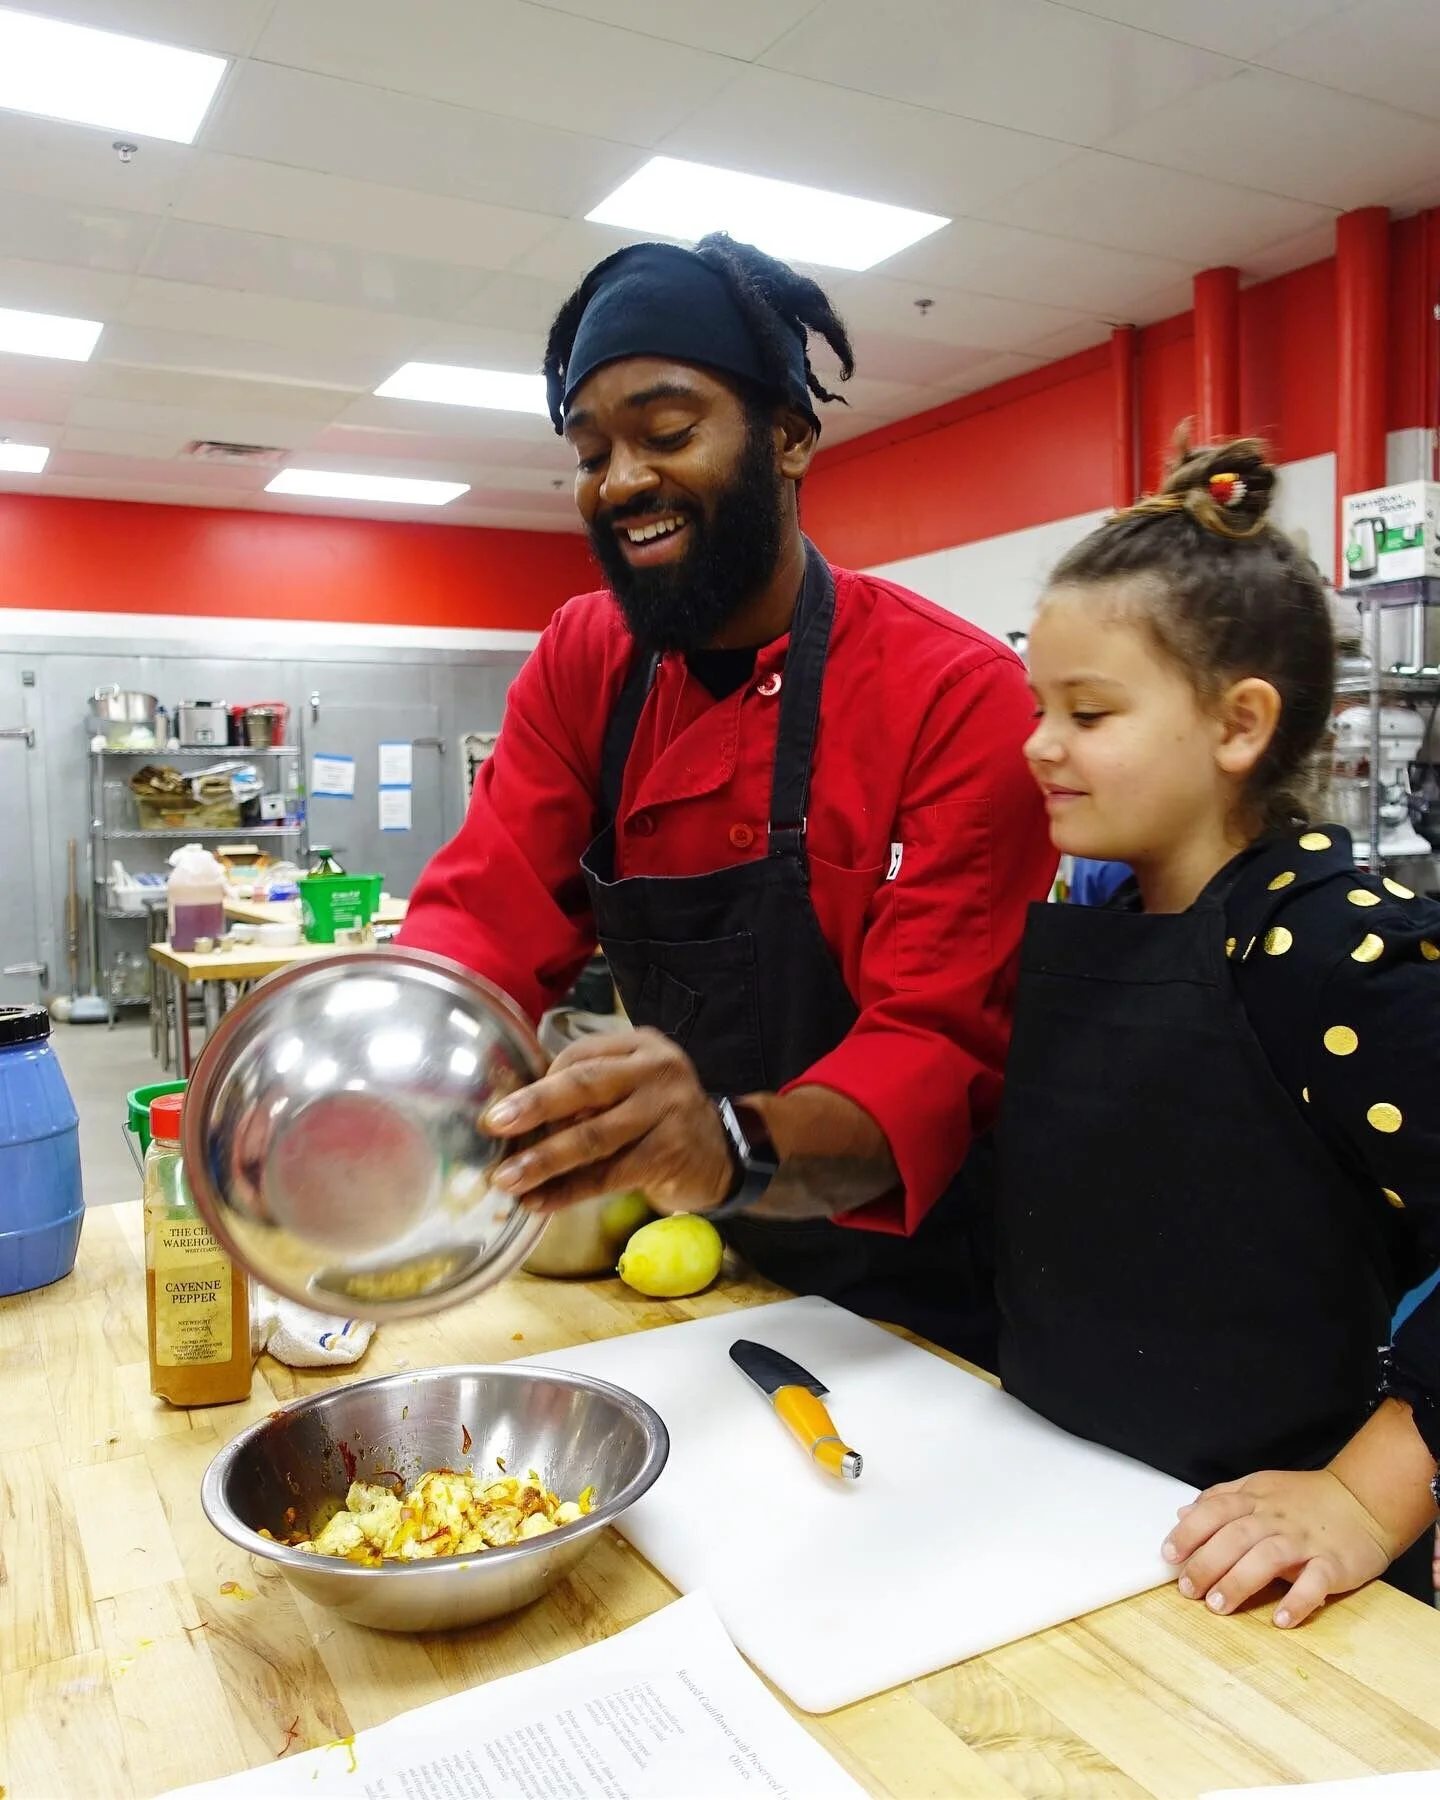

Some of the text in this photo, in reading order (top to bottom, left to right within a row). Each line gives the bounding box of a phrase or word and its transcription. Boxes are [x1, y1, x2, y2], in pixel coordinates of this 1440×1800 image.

[169, 1228, 192, 1237] THE
[165, 1279, 222, 1293] CAYENNE
[172, 1293, 217, 1304] PEPPER
[675, 1669, 704, 1696] Roasted
[697, 1696, 737, 1736] Cauliflower
[732, 1736, 751, 1753] with
[745, 1752, 784, 1790] Preserved
[727, 1754, 752, 1780] Olives
